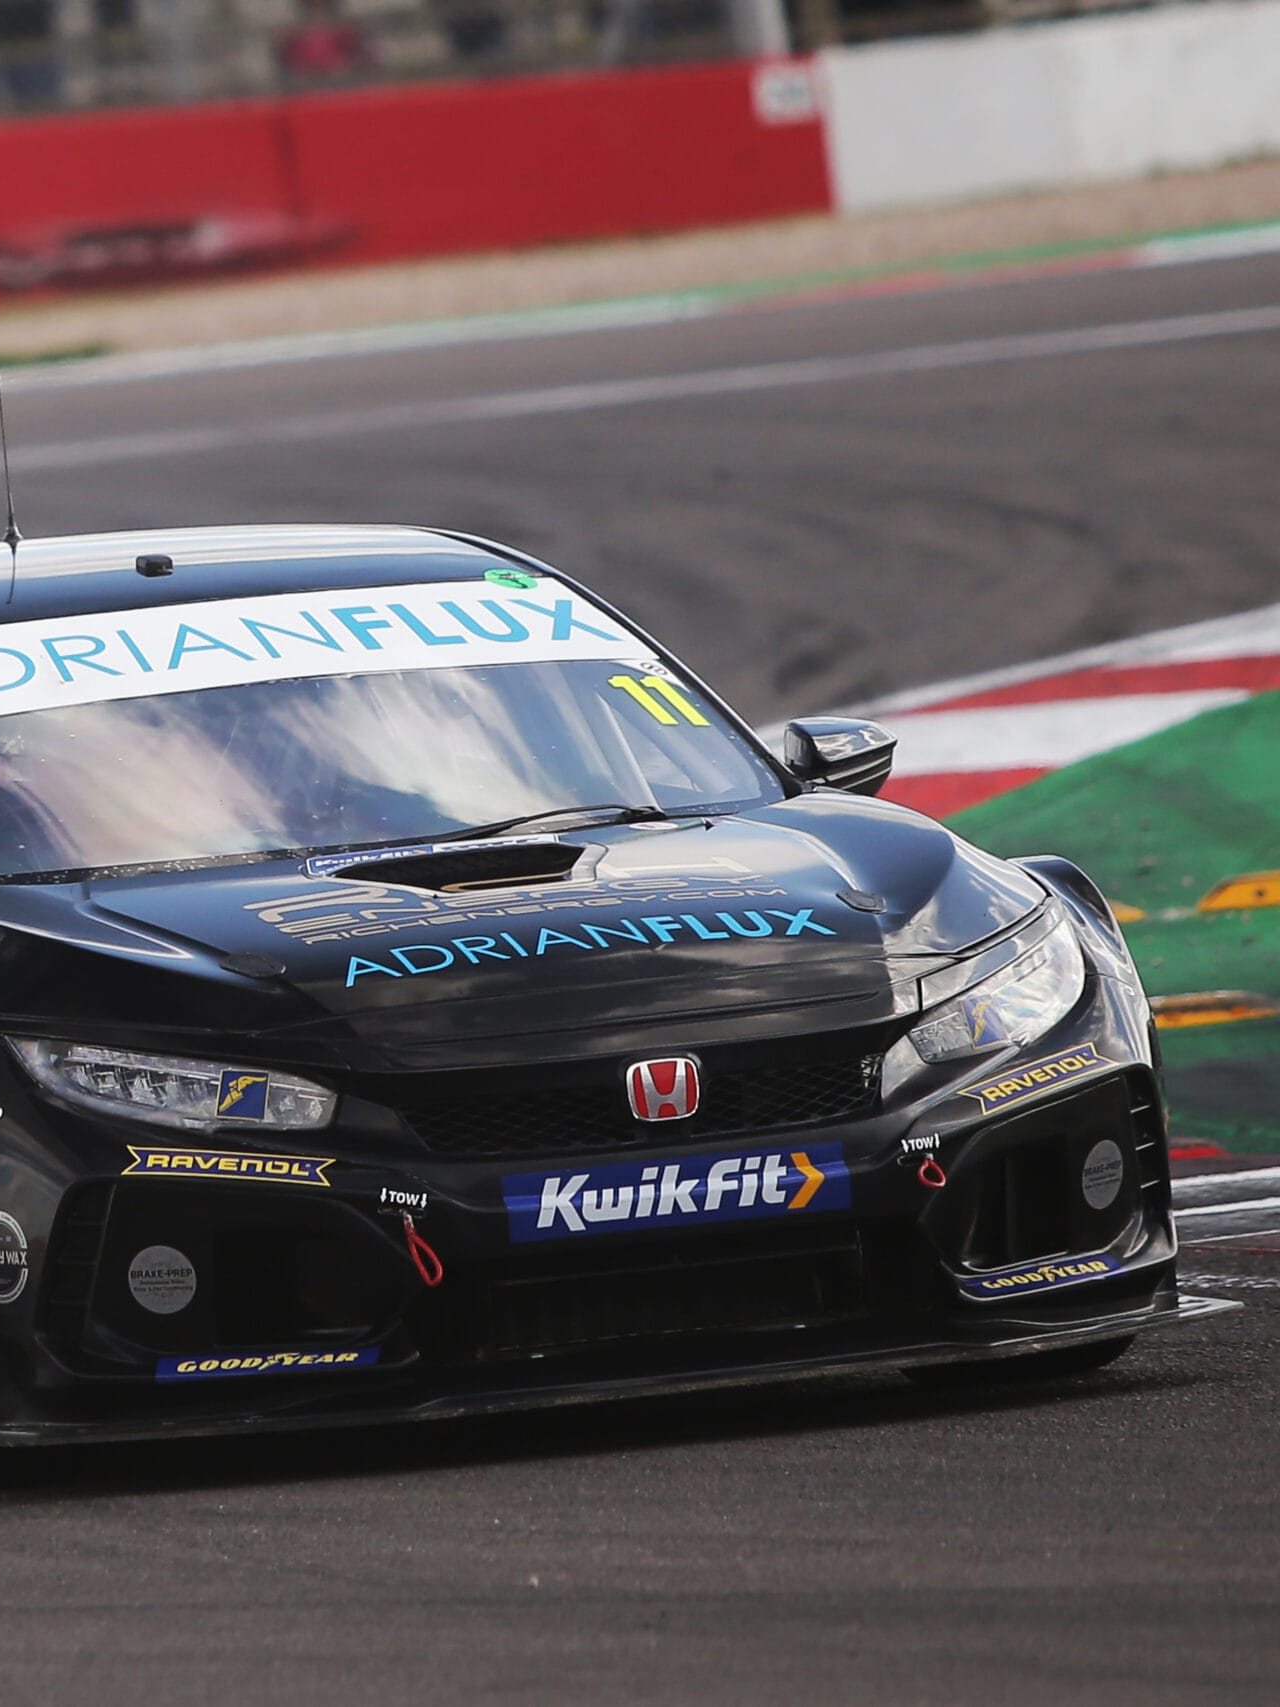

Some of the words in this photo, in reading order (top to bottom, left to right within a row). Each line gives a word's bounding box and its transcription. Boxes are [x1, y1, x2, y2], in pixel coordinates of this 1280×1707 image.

[608, 674, 710, 726] 11
[346, 908, 837, 987] ADRIANFLUX
[981, 1054, 1097, 1101] RAVENOL
[909, 1137, 934, 1150] TOW
[146, 1154, 310, 1176] RAVENOL
[388, 1190, 421, 1206] TOW
[5, 1250, 28, 1266] WAX
[130, 1268, 193, 1279] BRAKE-PREP
[982, 1260, 1110, 1289] GOODYEAR
[176, 1351, 359, 1374] GOODYEAR
